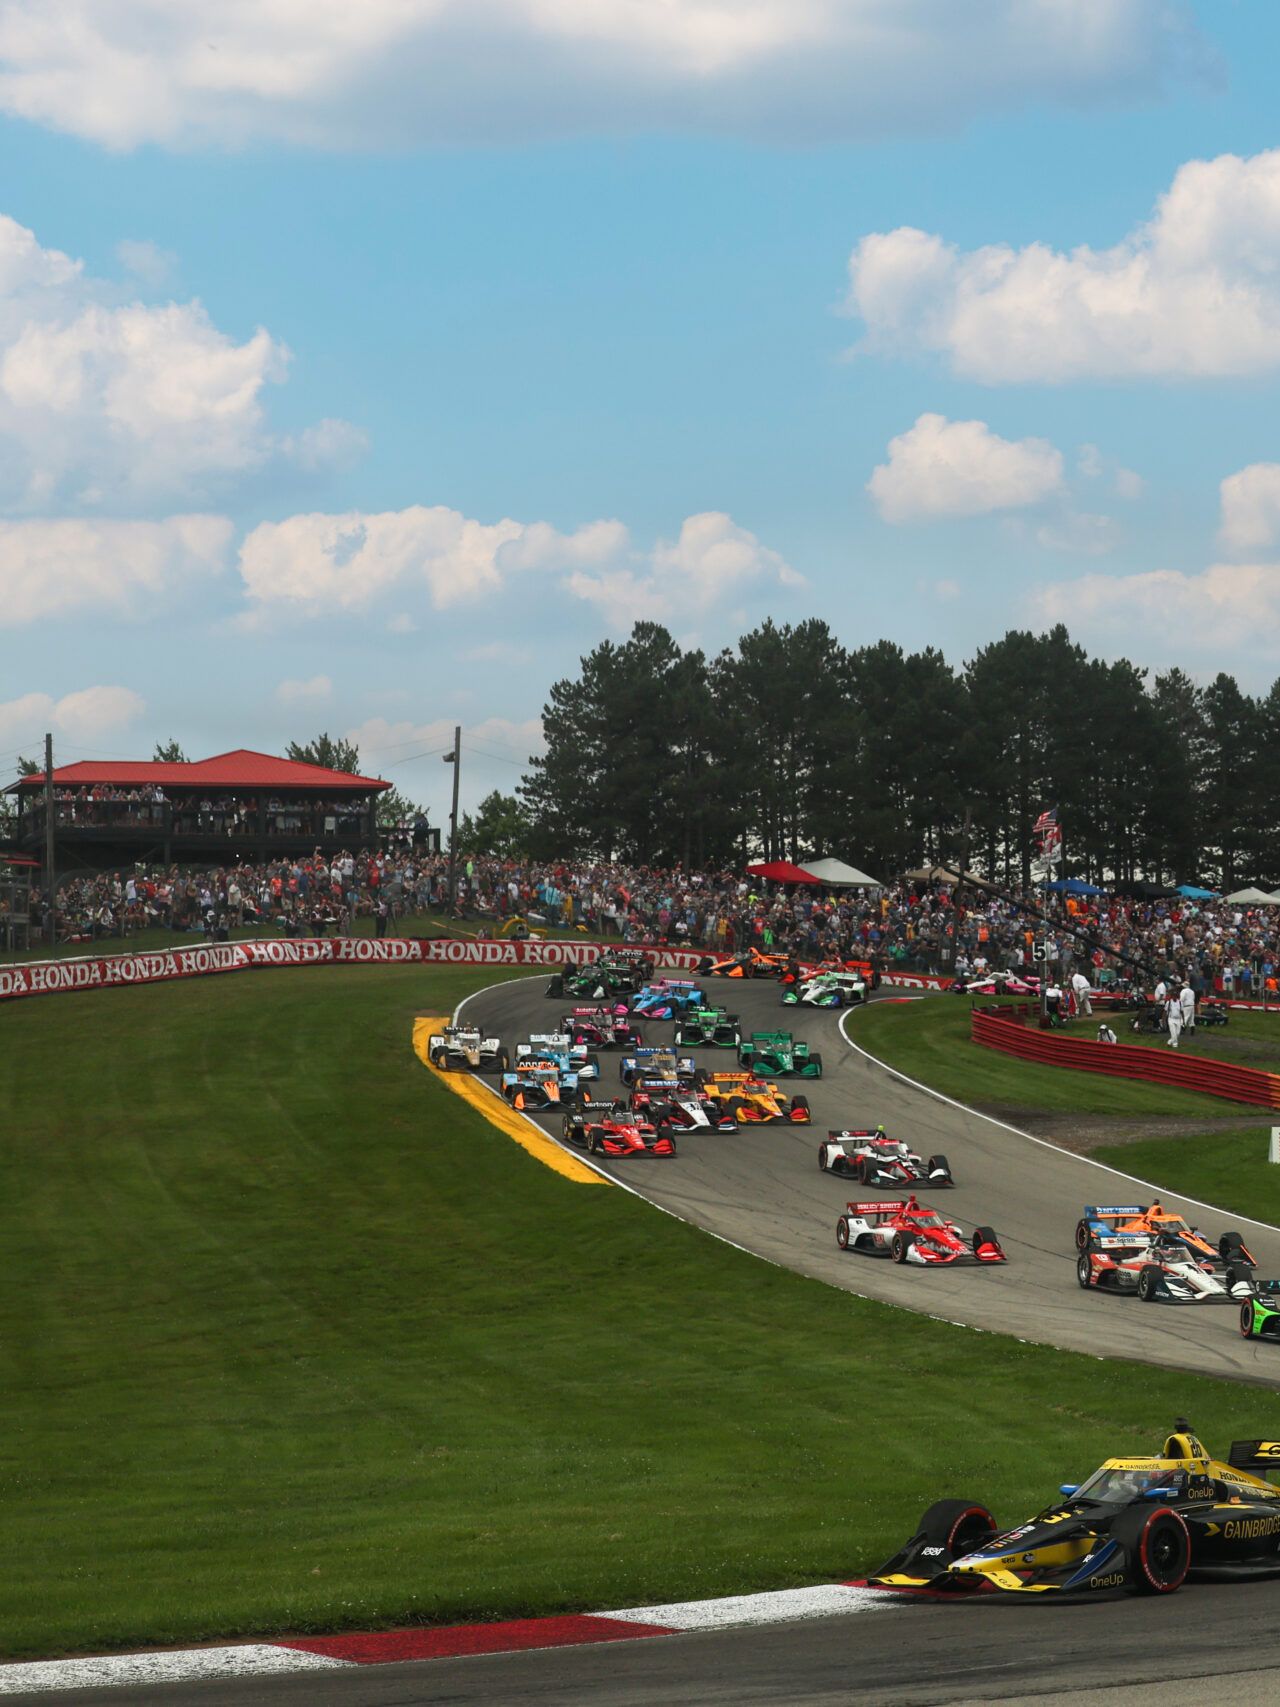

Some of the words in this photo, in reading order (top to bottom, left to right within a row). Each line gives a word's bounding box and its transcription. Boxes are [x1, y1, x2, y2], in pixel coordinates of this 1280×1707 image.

[251, 941, 335, 963] HONDA
[338, 939, 423, 961] HONDA
[426, 940, 519, 964] HONDA
[1034, 941, 1046, 961] 5
[30, 962, 102, 991] HONDA
[105, 955, 179, 983] HONDA
[180, 945, 249, 973] HONDA
[1188, 1486, 1214, 1499] OneUp
[1223, 1515, 1280, 1539] GAINBRIDGE
[1090, 1574, 1124, 1588] OneUp
